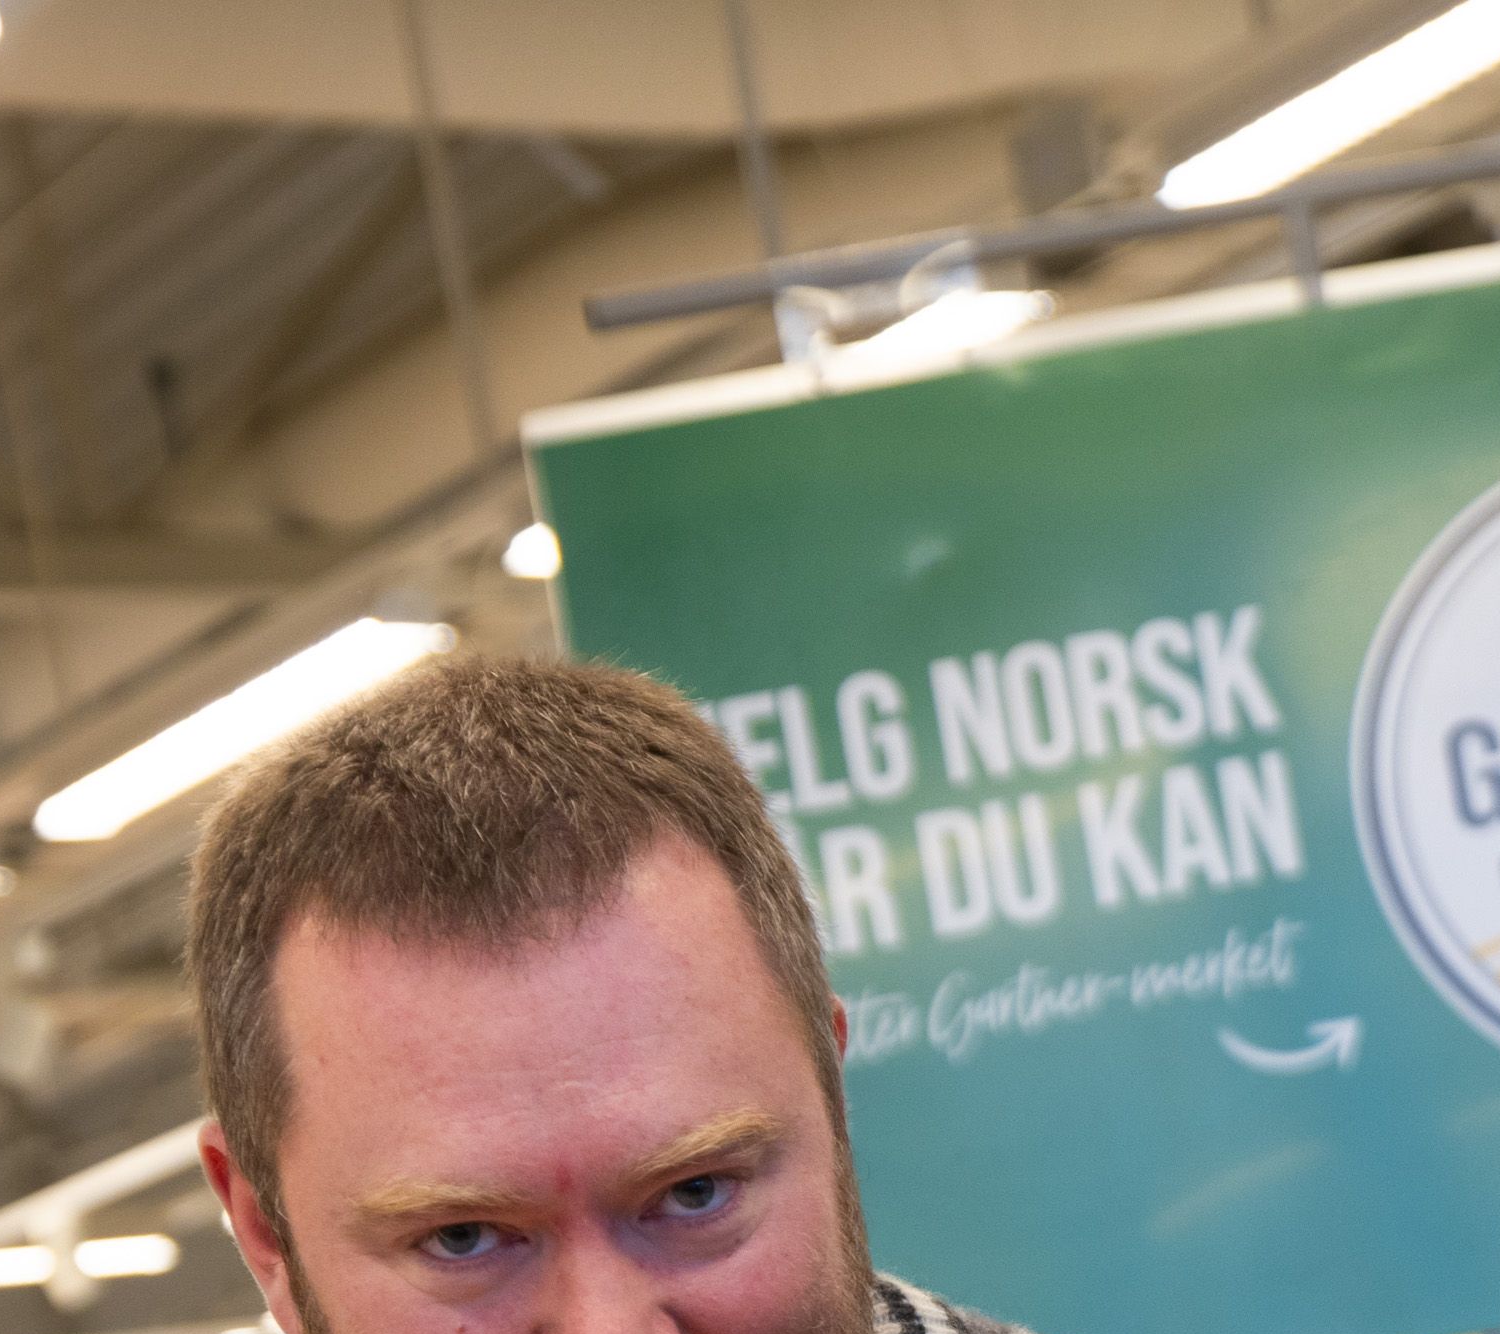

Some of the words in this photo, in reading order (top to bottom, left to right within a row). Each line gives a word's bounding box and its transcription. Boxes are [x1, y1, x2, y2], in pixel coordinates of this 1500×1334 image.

[702, 668, 914, 816] ELG
[927, 602, 1280, 787] NORSK
[914, 794, 1058, 942] DU
[1076, 750, 1305, 908] KAN
